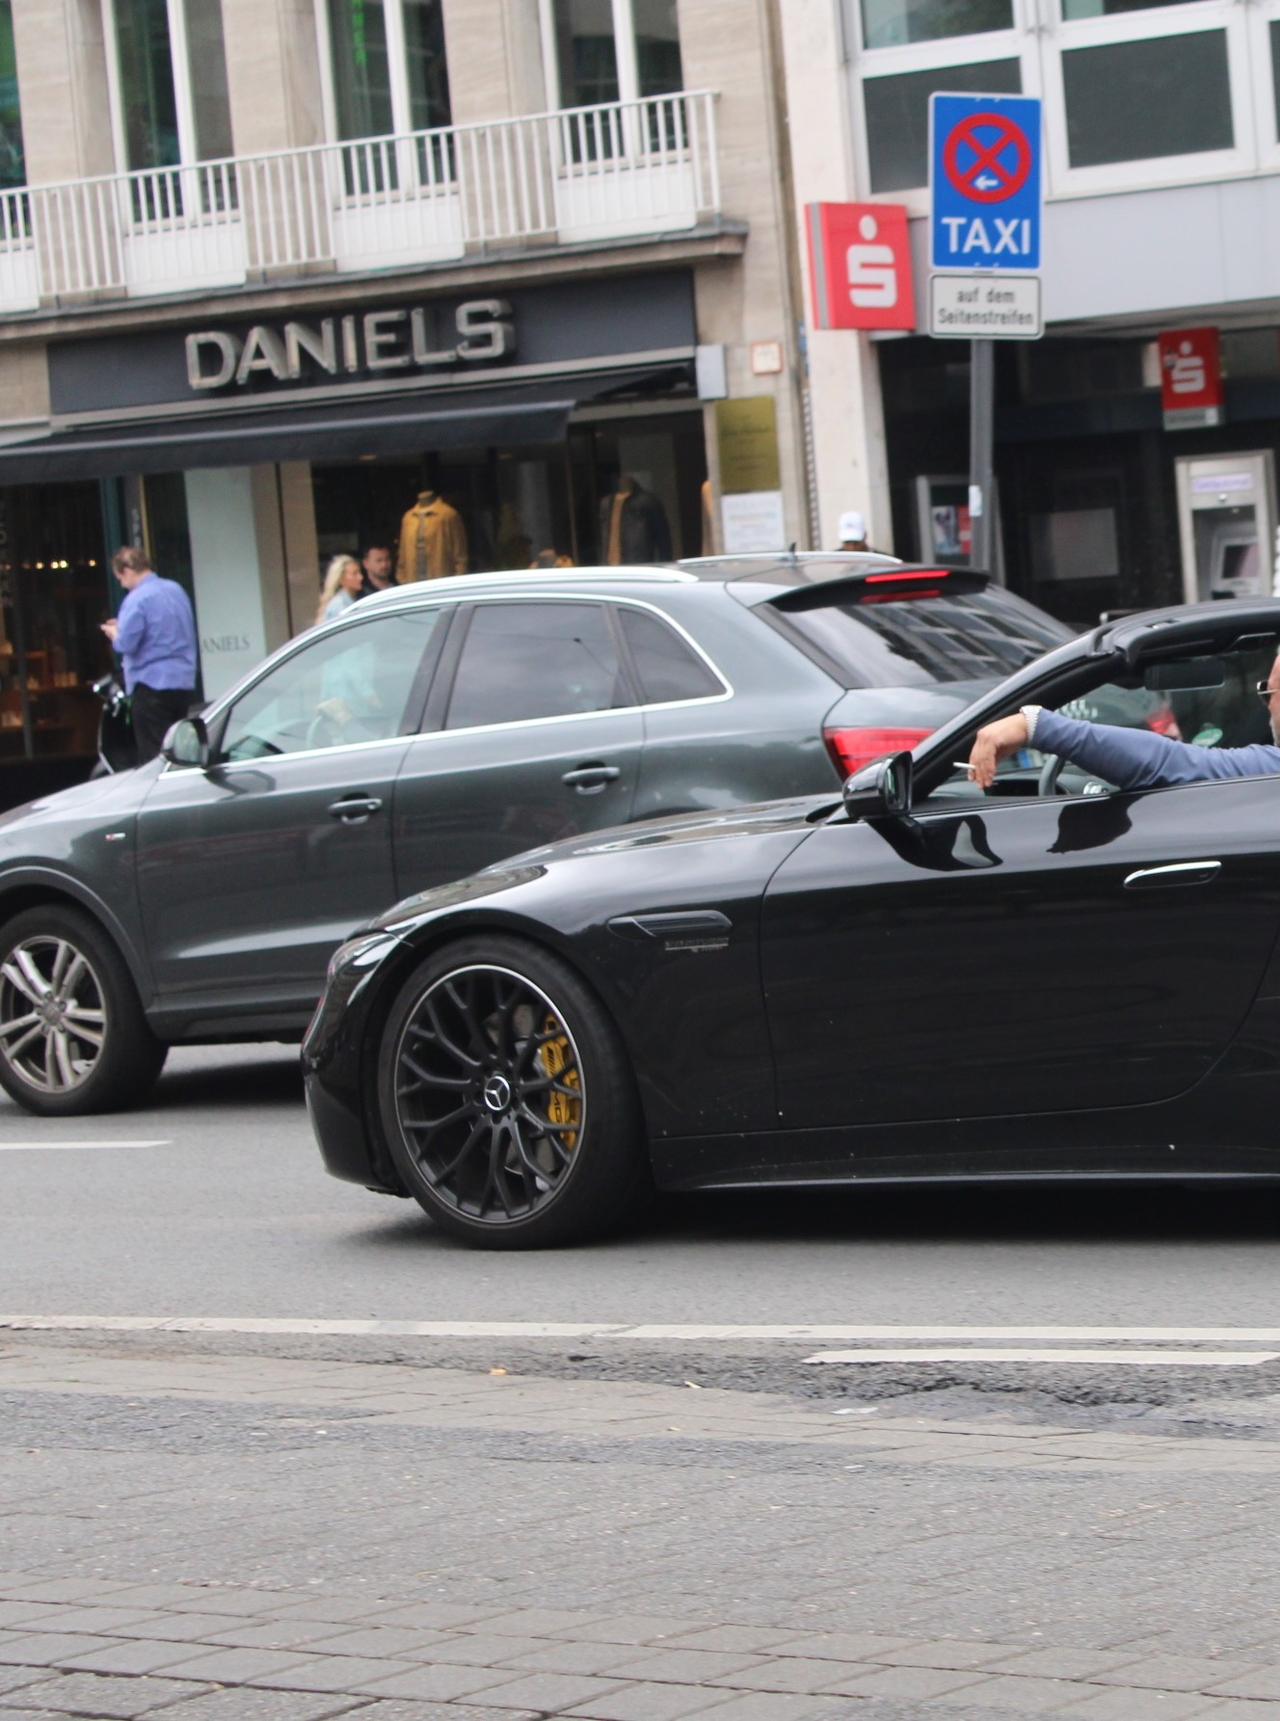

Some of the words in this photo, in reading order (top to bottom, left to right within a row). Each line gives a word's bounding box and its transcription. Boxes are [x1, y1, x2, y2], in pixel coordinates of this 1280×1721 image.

[941, 217, 1031, 254] TAXI
[957, 287, 979, 302] auf
[986, 287, 1015, 303] dem
[939, 307, 1034, 325] Seitenstreifen
[185, 299, 509, 390] DANIELS
[202, 633, 250, 653] ANIELS
